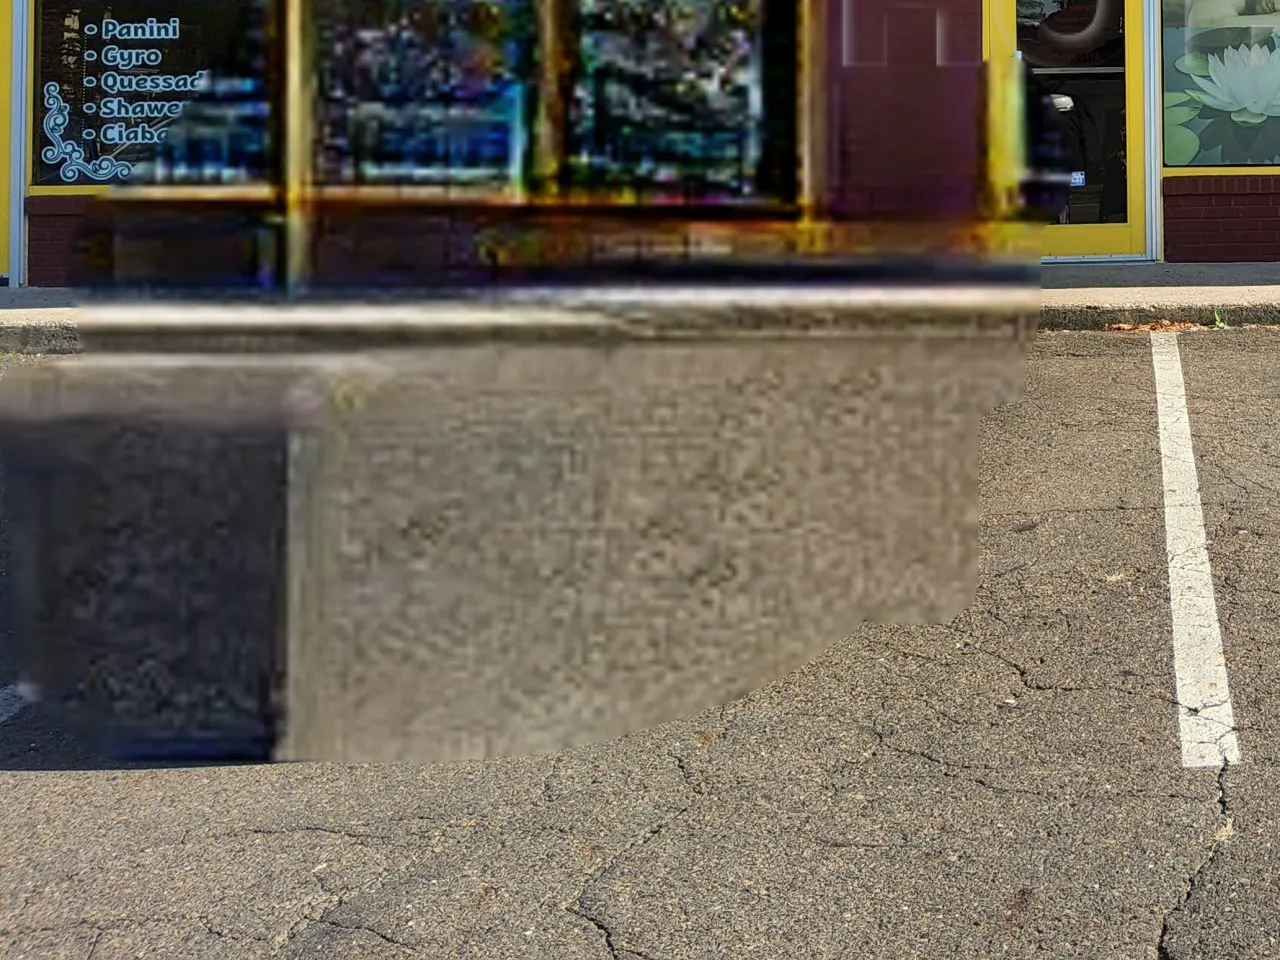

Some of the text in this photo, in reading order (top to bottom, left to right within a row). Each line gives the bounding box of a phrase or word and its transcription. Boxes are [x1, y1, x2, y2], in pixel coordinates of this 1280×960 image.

[101, 17, 180, 39] Panini
[101, 45, 162, 69] Gyro
[101, 70, 211, 93] Quessad
[100, 97, 184, 118] Shawe
